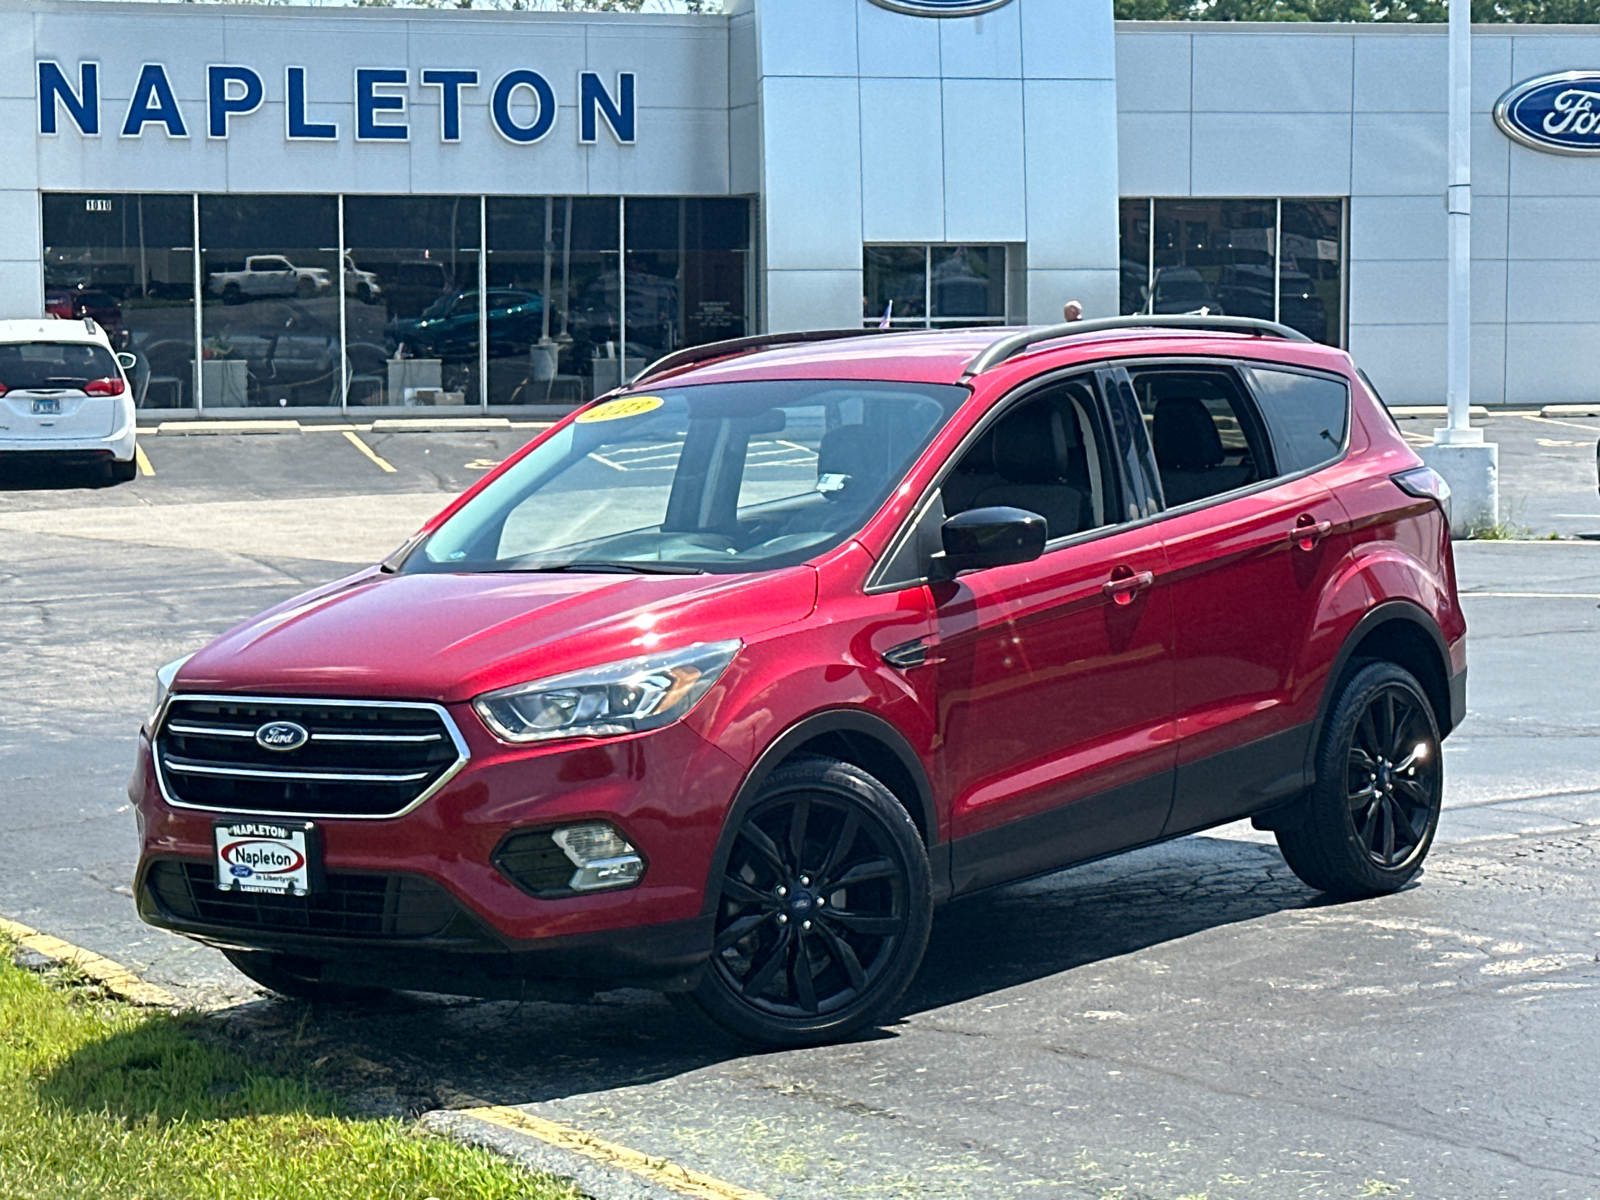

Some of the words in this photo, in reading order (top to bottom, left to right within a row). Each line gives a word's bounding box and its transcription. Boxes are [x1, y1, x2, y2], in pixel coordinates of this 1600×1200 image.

[36, 60, 637, 145] NAPLETON
[86, 199, 112, 211] 1010
[265, 727, 294, 743] Ford
[232, 824, 286, 838] NAPLETON
[235, 846, 292, 868] Napleton
